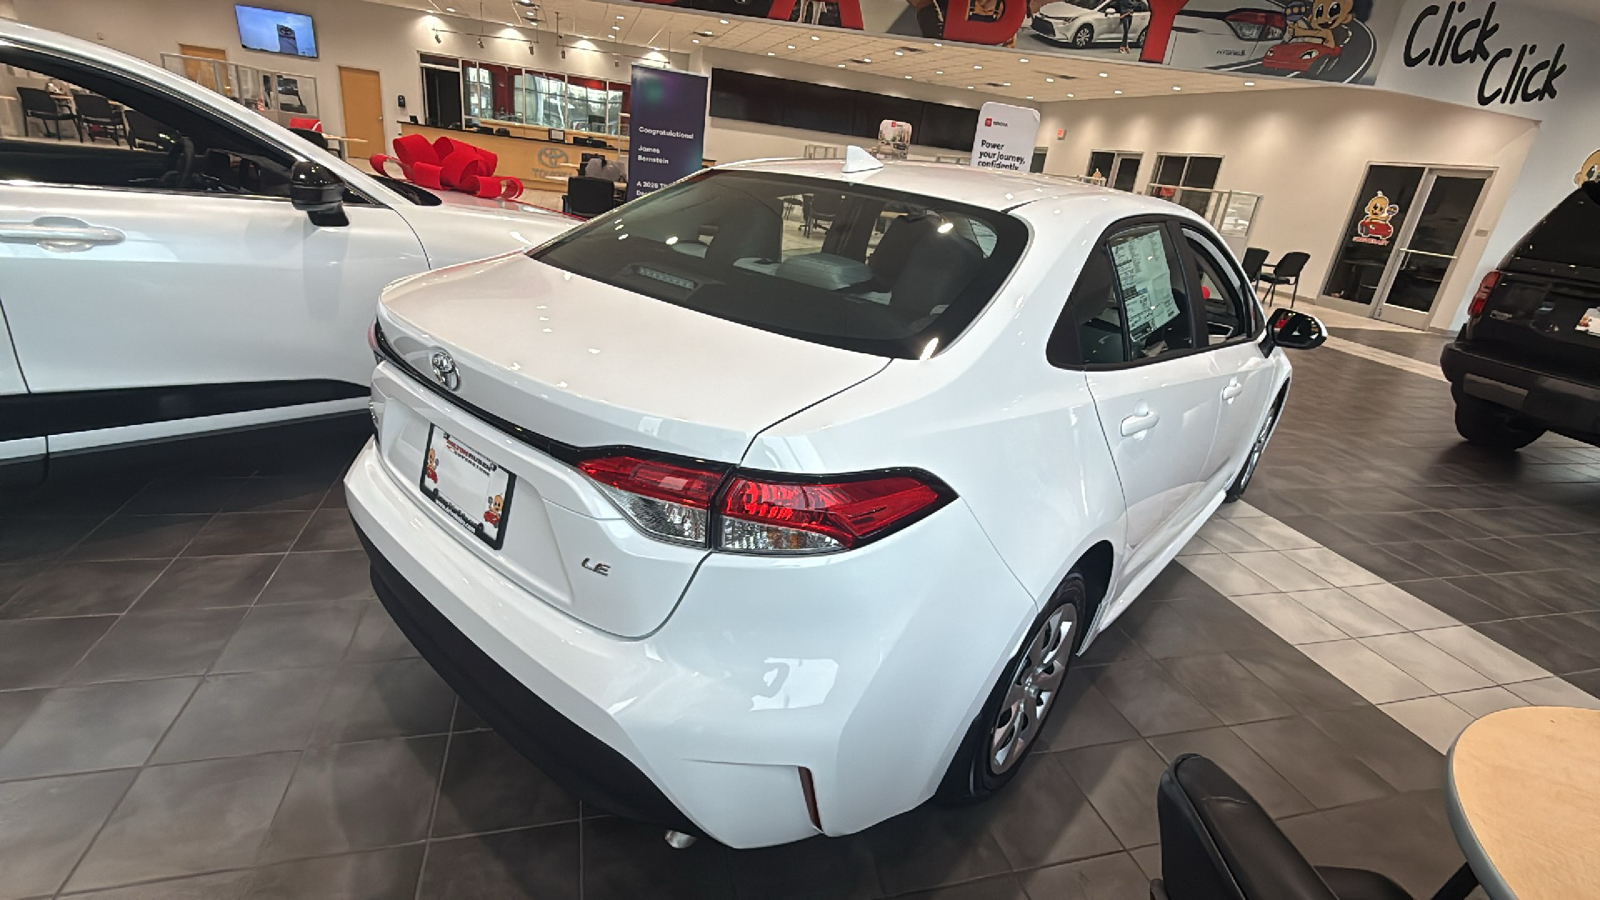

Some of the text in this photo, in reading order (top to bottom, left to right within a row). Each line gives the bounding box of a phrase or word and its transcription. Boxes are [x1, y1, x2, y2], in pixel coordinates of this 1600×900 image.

[1403, 1, 1500, 68] Click
[1477, 43, 1568, 106] Click
[638, 126, 694, 140] Congratulations!
[637, 144, 661, 154] James
[981, 139, 1005, 151] Power
[637, 154, 669, 164] Bernstein
[978, 150, 1026, 165] your journey,
[581, 557, 611, 577] LE
